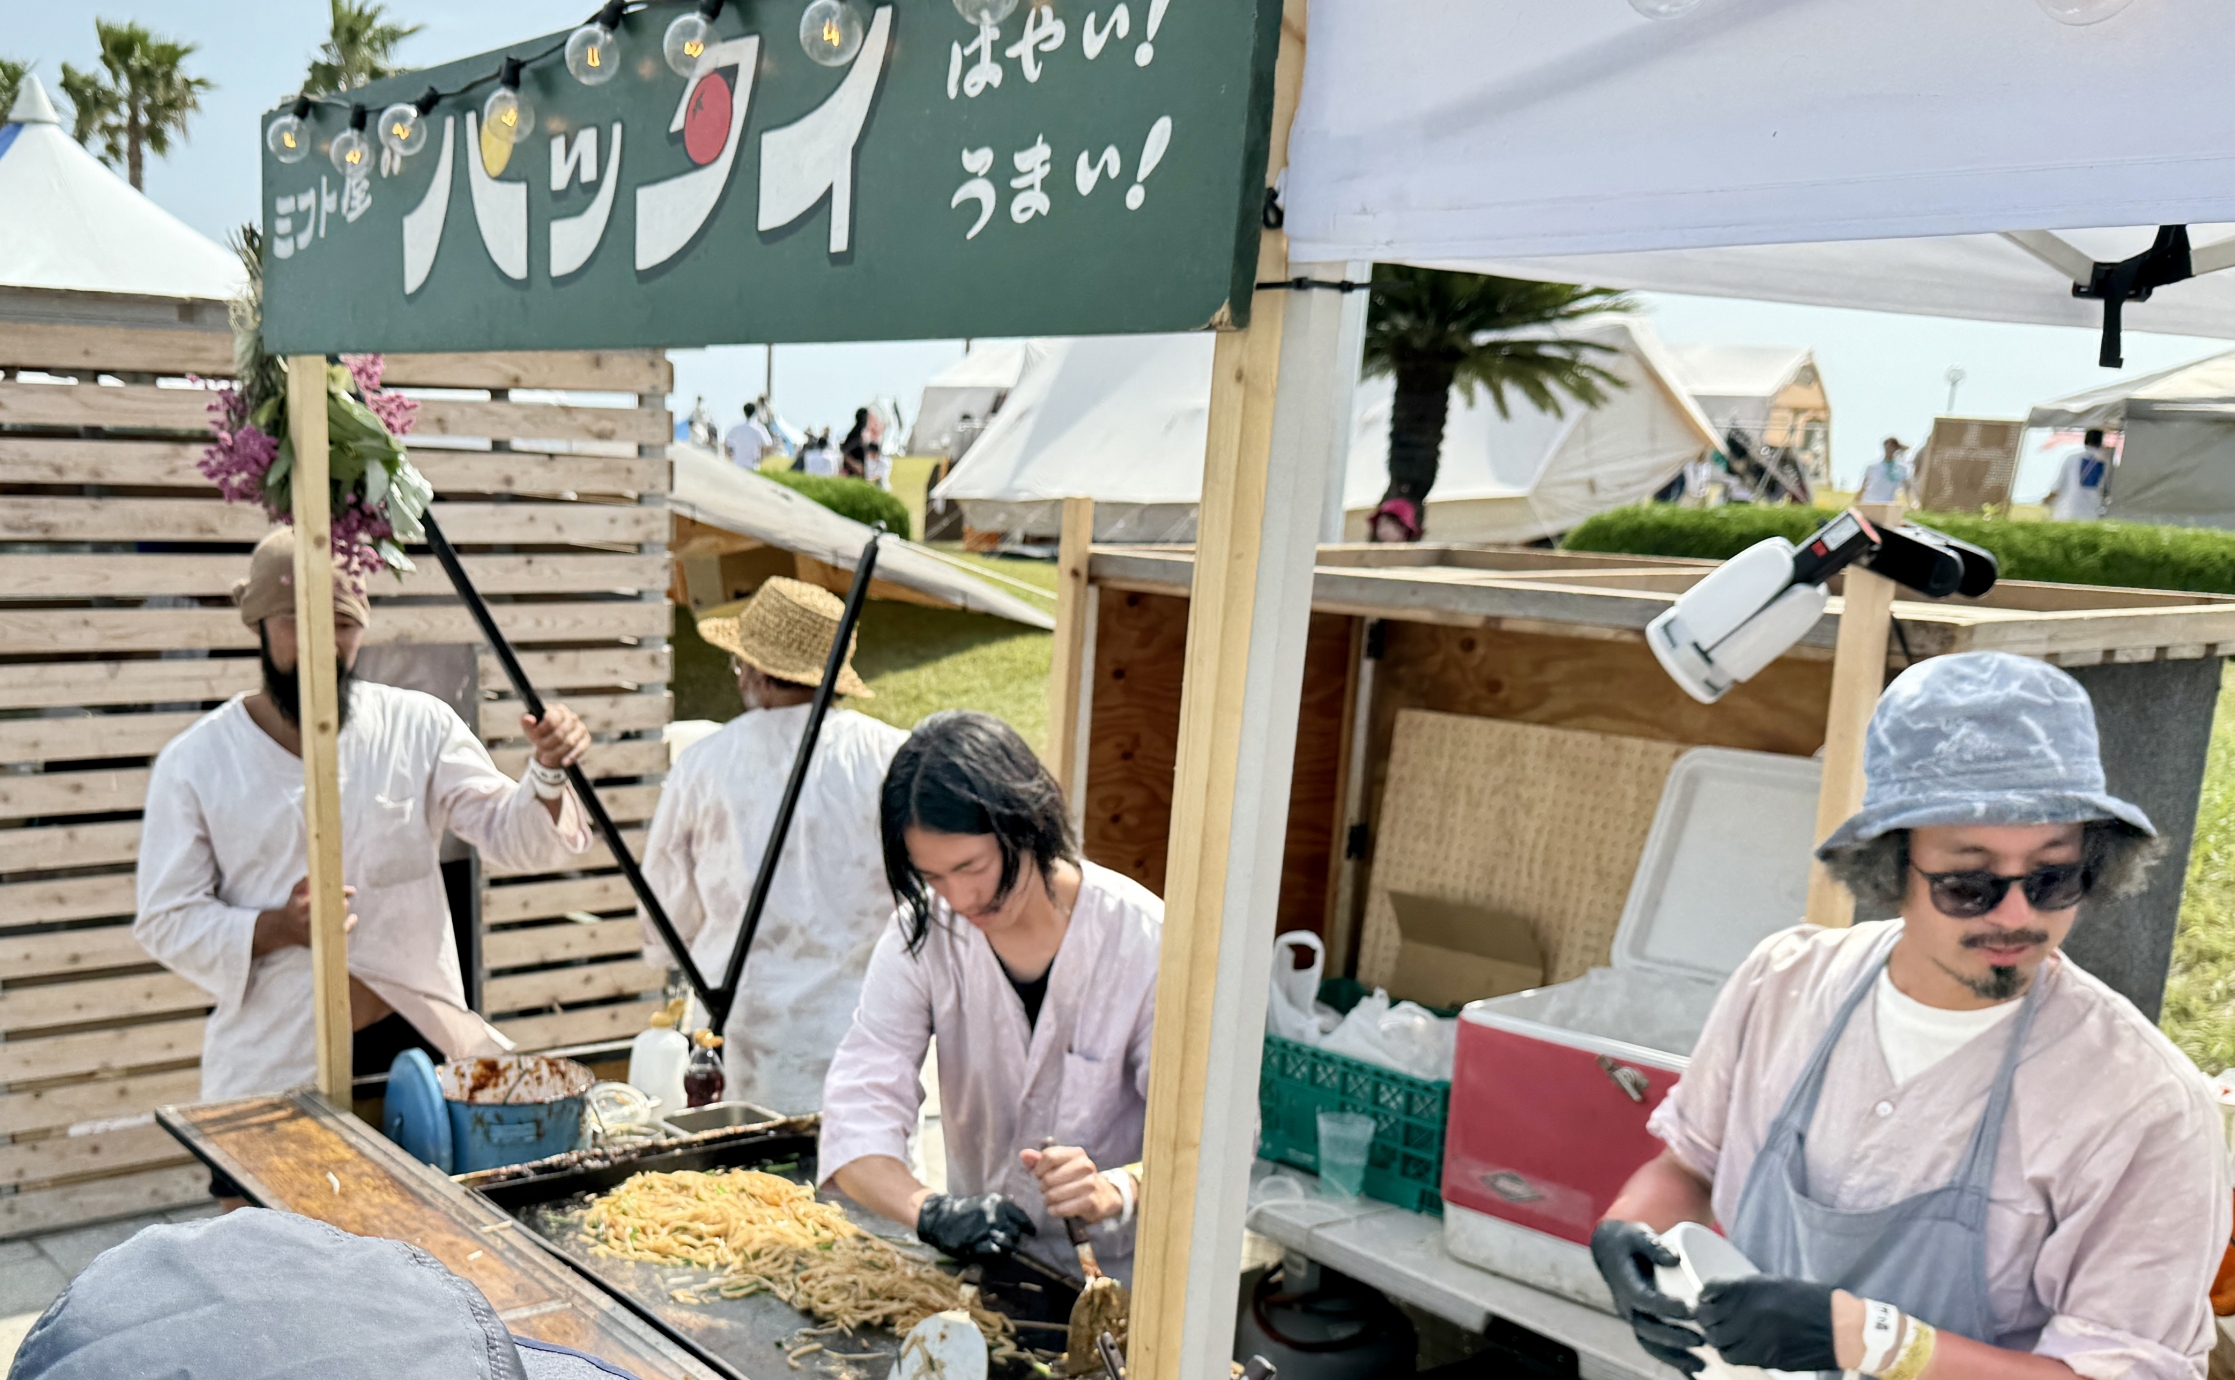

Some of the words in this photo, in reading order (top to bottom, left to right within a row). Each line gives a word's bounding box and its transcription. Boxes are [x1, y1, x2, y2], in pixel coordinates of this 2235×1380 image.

[947, 0, 1172, 100] はやい!
[951, 115, 1173, 240] うまい!
